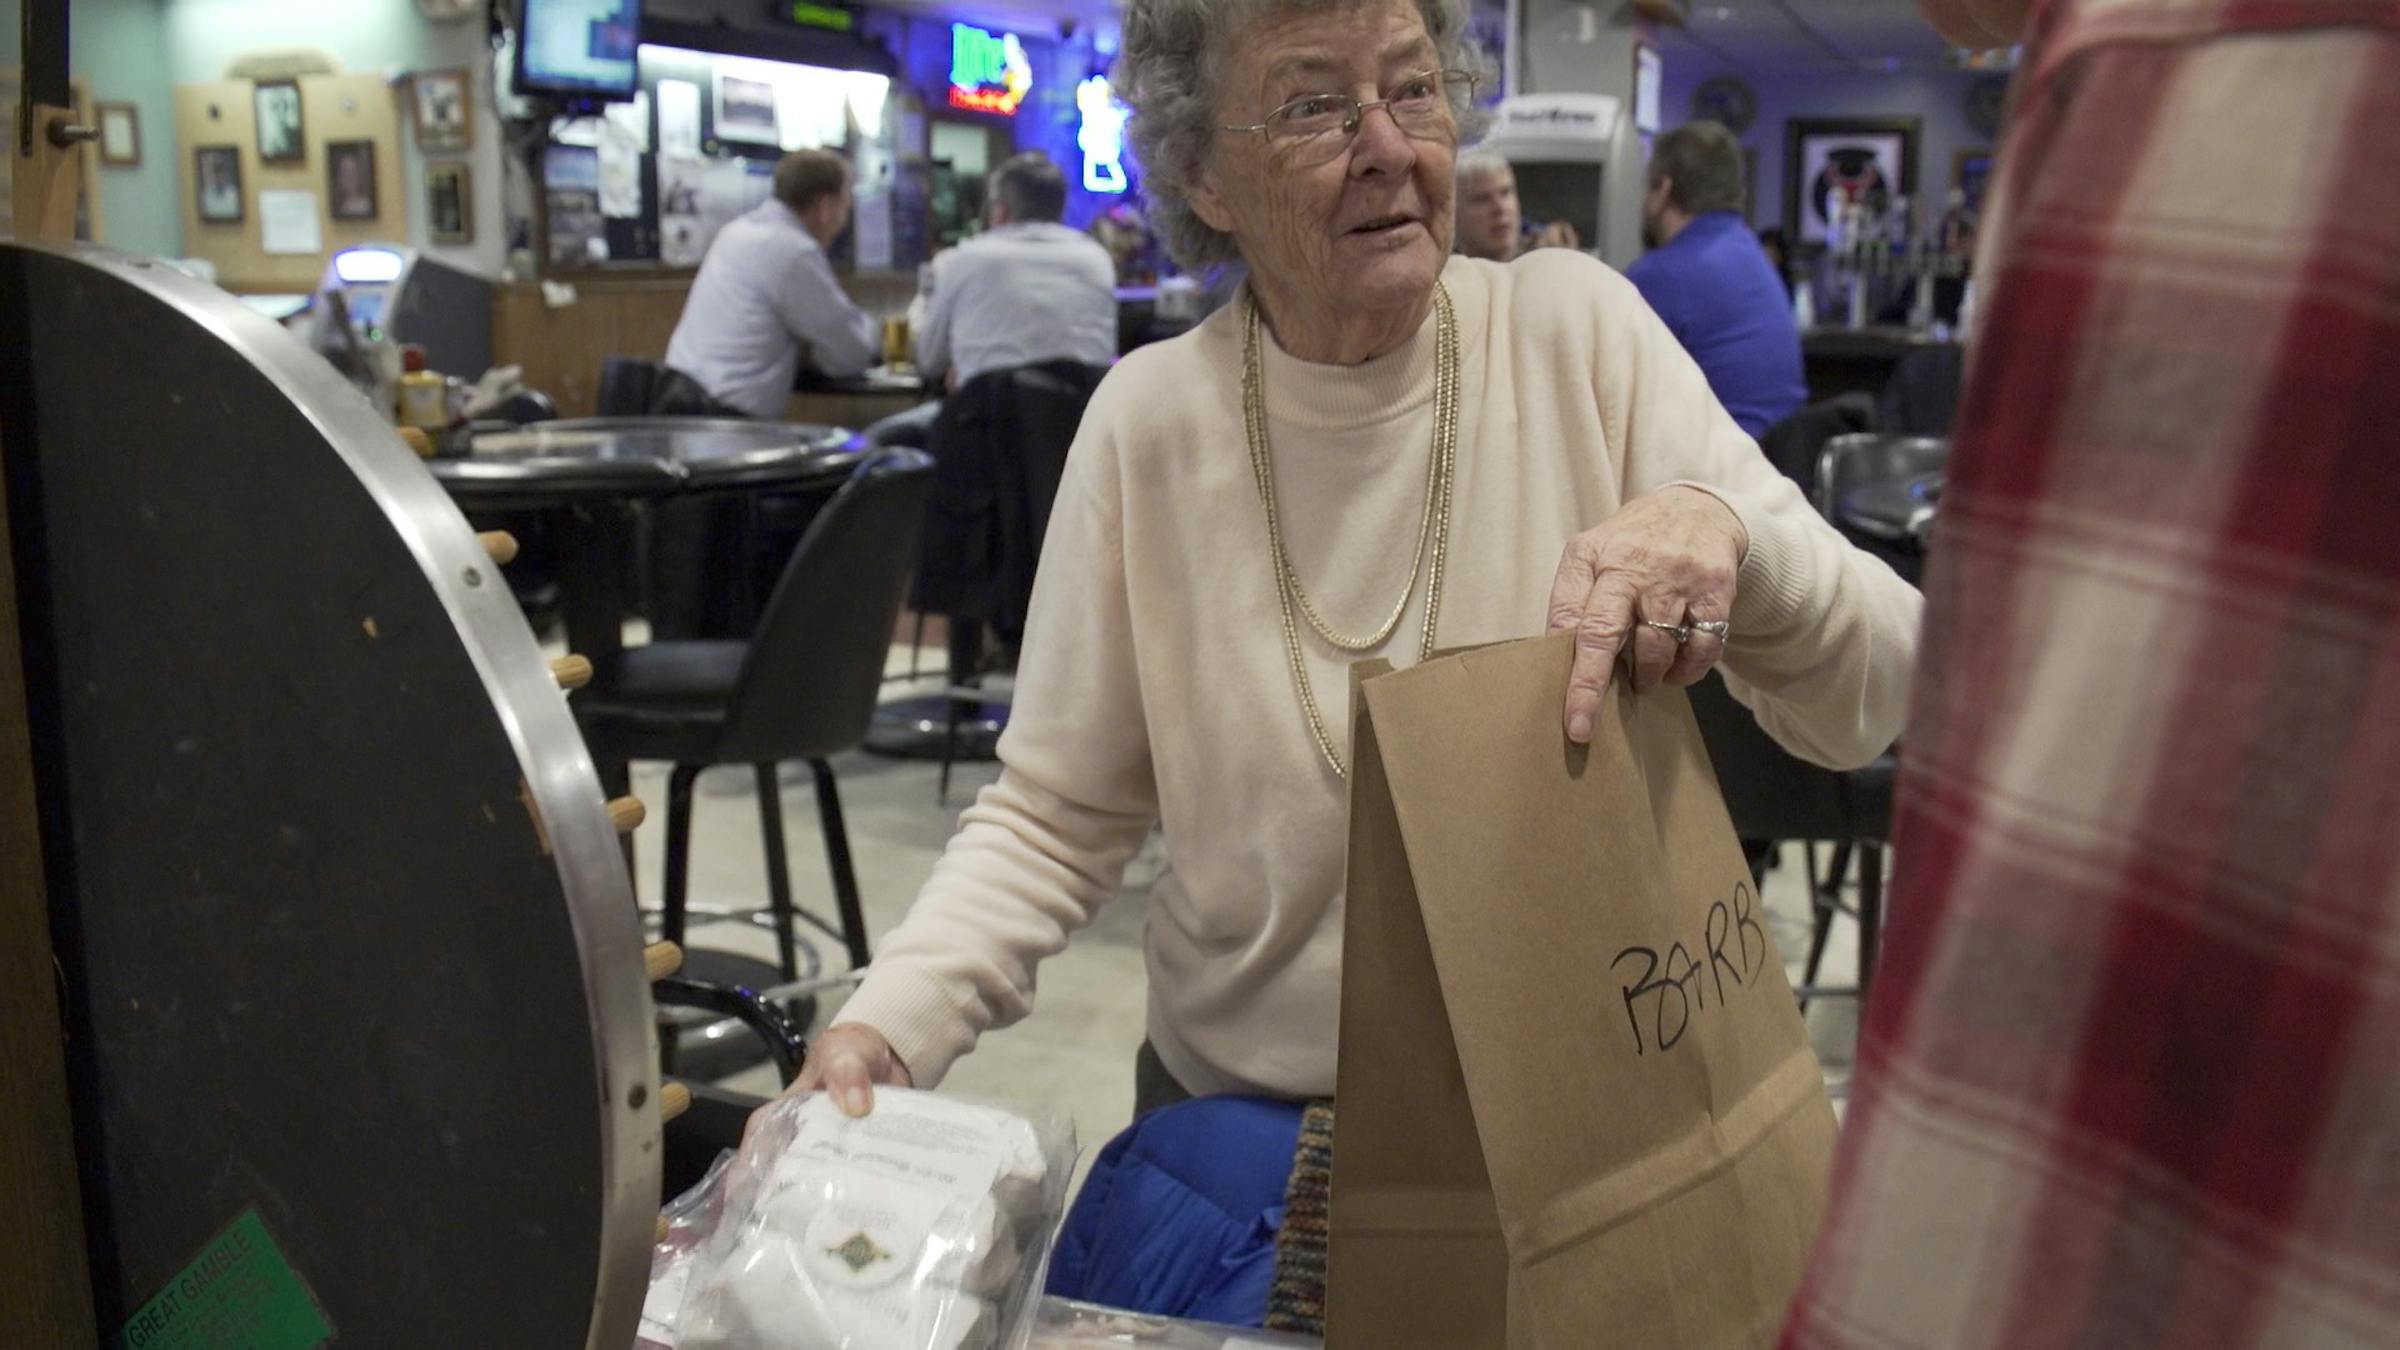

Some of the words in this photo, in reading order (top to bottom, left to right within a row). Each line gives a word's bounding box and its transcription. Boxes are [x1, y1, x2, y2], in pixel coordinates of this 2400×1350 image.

[1609, 880, 1766, 1057] BARB
[127, 1290, 183, 1349] GREAT
[181, 1229, 252, 1301] GAMBLE
